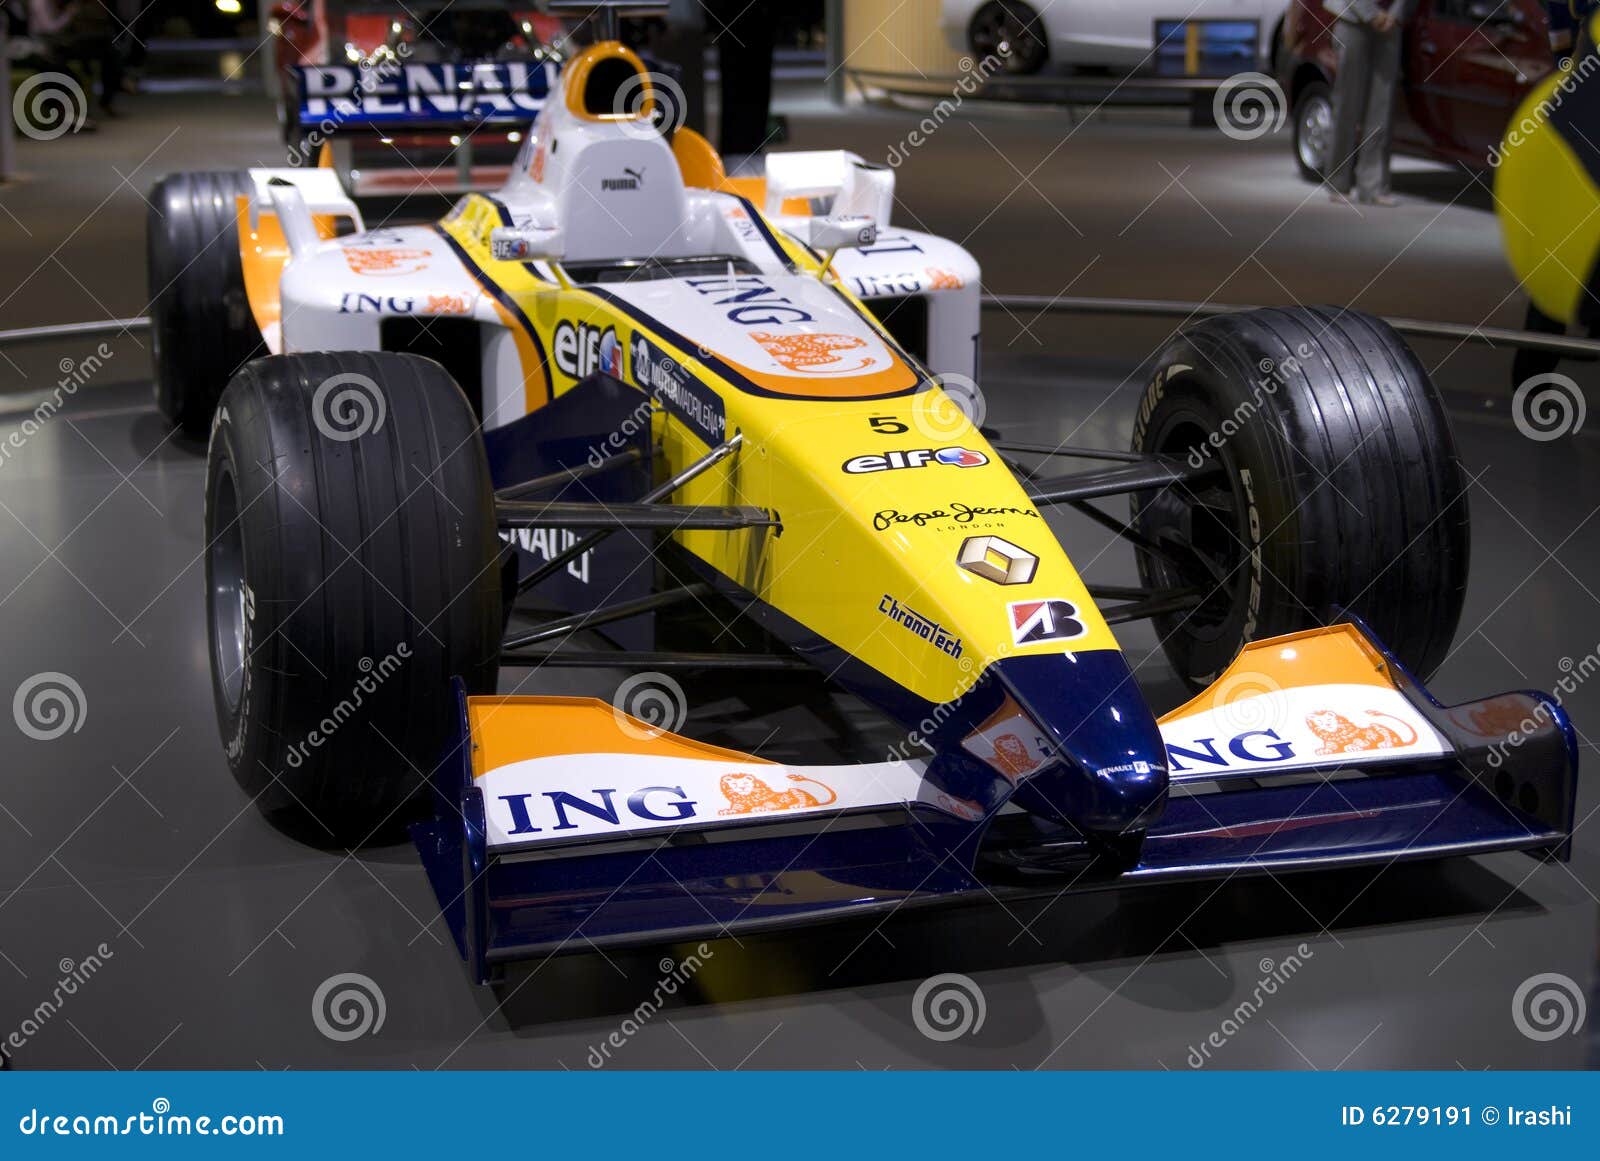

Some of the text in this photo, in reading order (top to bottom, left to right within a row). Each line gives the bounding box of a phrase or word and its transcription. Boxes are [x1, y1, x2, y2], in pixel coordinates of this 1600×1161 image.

[601, 177, 638, 190] PUMA
[338, 293, 415, 314] ING
[685, 278, 817, 325] ING
[868, 416, 909, 435] 5
[873, 503, 1042, 532] Pepe Jeans
[936, 523, 1006, 533] LONDON
[1164, 728, 1297, 773] NG
[1096, 764, 1133, 777] RENAULT
[498, 785, 698, 835] ING
